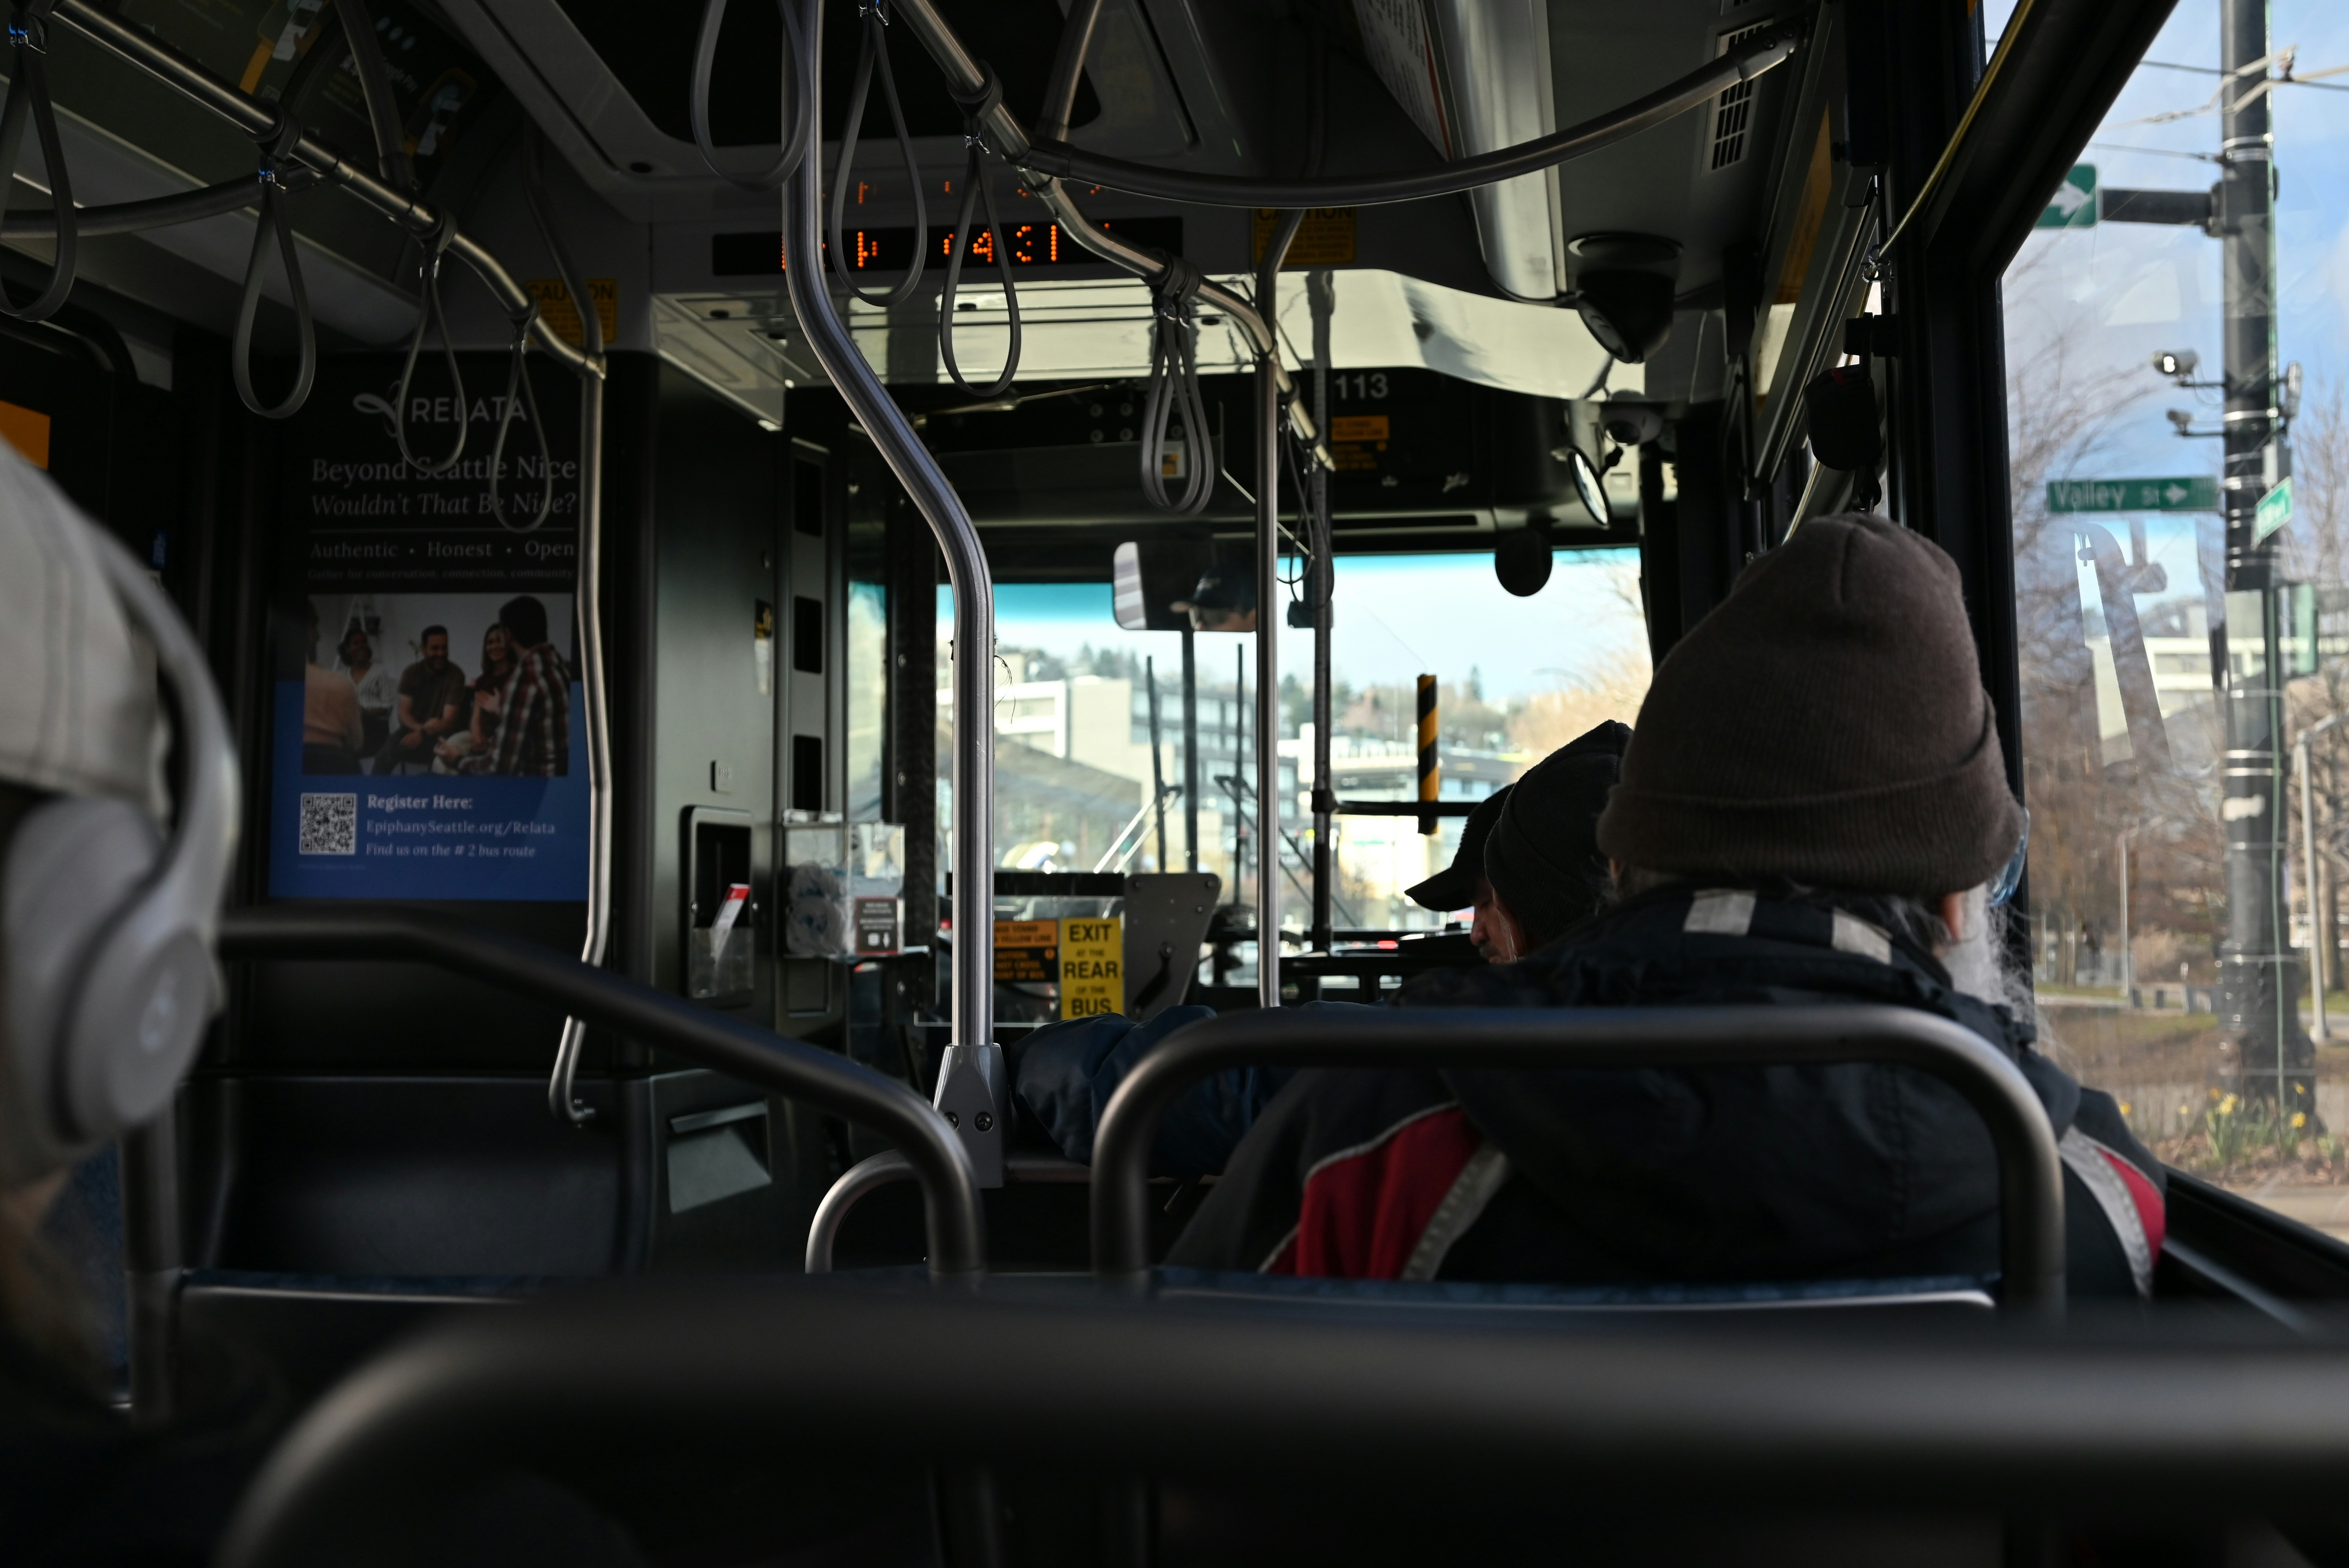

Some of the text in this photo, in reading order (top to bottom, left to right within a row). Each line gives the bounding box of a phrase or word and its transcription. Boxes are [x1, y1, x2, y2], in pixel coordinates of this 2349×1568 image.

[1334, 372, 1390, 400] 113
[411, 396, 528, 423] RELATA
[312, 455, 577, 488] Beyond Seattle Nice
[312, 492, 577, 516] Wouldn't That Be Nice?
[2054, 481, 2126, 510] Valley
[310, 540, 575, 561] Authentic Honest Open
[367, 794, 474, 813] Register Here:
[366, 819, 556, 837] EpiphanySeattle.org/Relata
[366, 843, 391, 857] Find
[396, 845, 409, 857] us
[413, 846, 429, 857] on
[432, 843, 450, 857] the
[478, 843, 499, 857] bus
[503, 845, 536, 857] route
[1069, 923, 1111, 942] EXIT
[1064, 960, 1118, 979] REAR
[1071, 998, 1112, 1016] BUS
